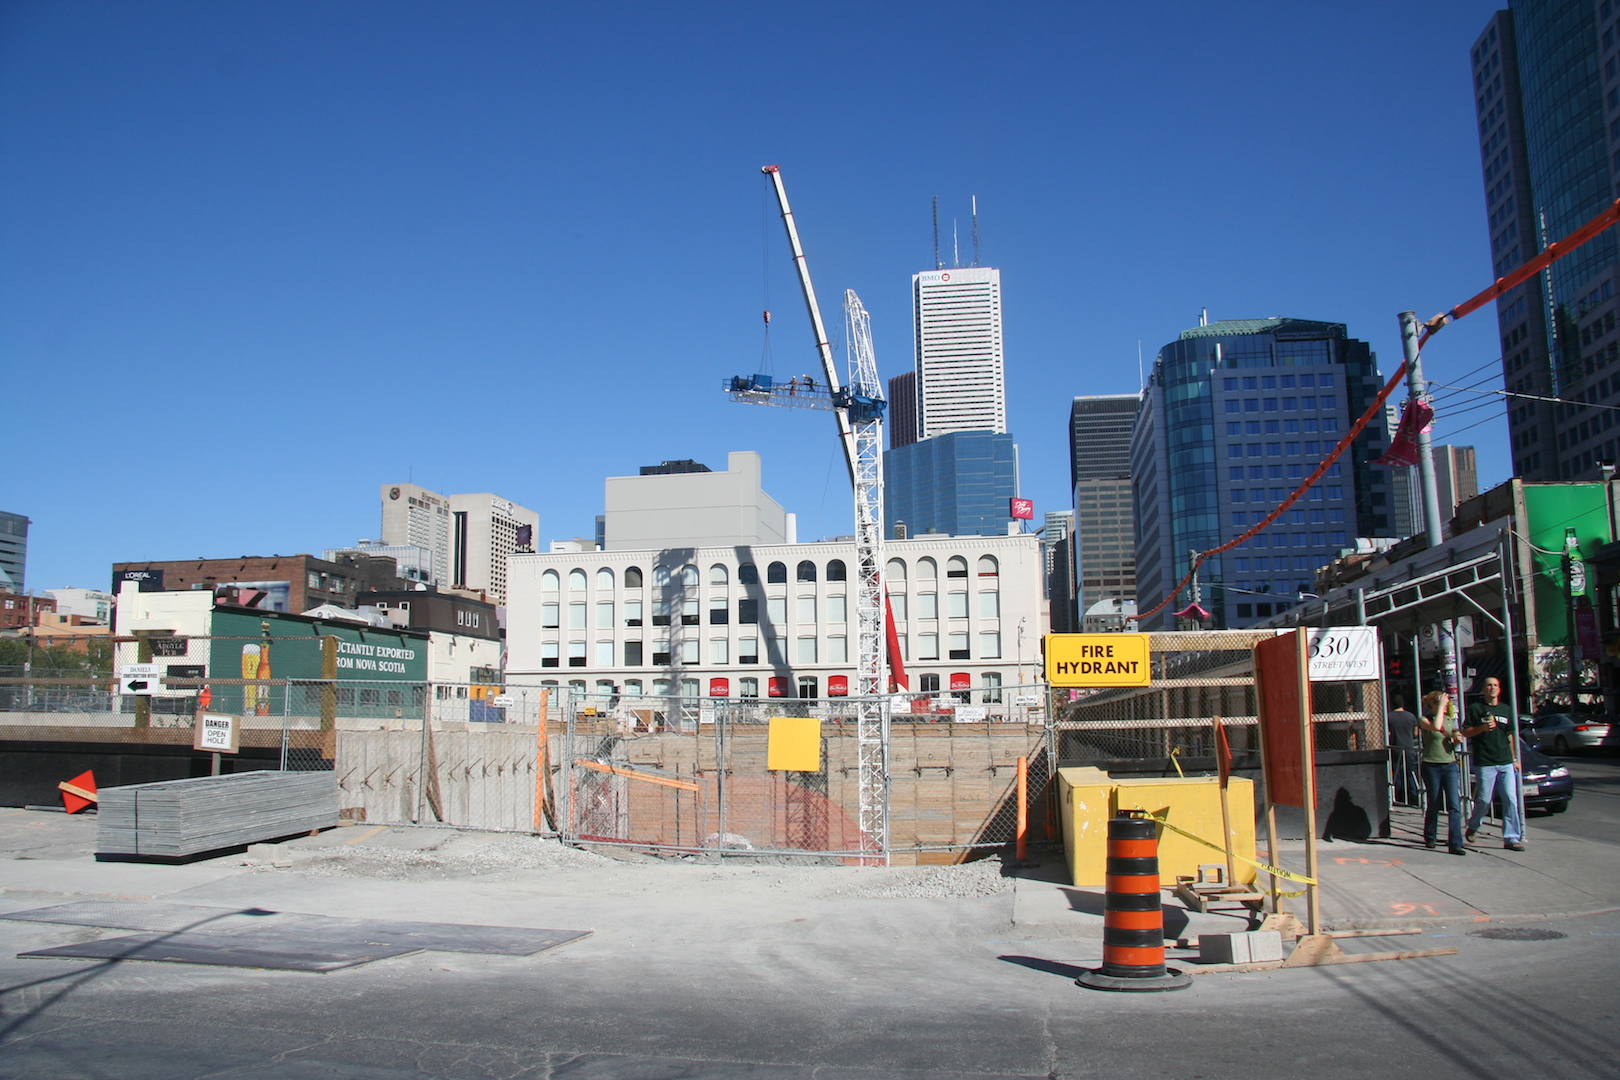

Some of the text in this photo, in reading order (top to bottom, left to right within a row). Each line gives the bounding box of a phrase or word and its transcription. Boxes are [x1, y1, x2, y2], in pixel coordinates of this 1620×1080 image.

[376, 646, 414, 660] EXPORTED
[1082, 646, 1114, 658] FIRE
[1309, 636, 1349, 658] 330
[336, 657, 406, 673] ROM NOVA SCOTIA
[1057, 662, 1138, 674] HYDRANT
[205, 720, 229, 728] DANGER
[1262, 864, 1291, 879] CAUTION
